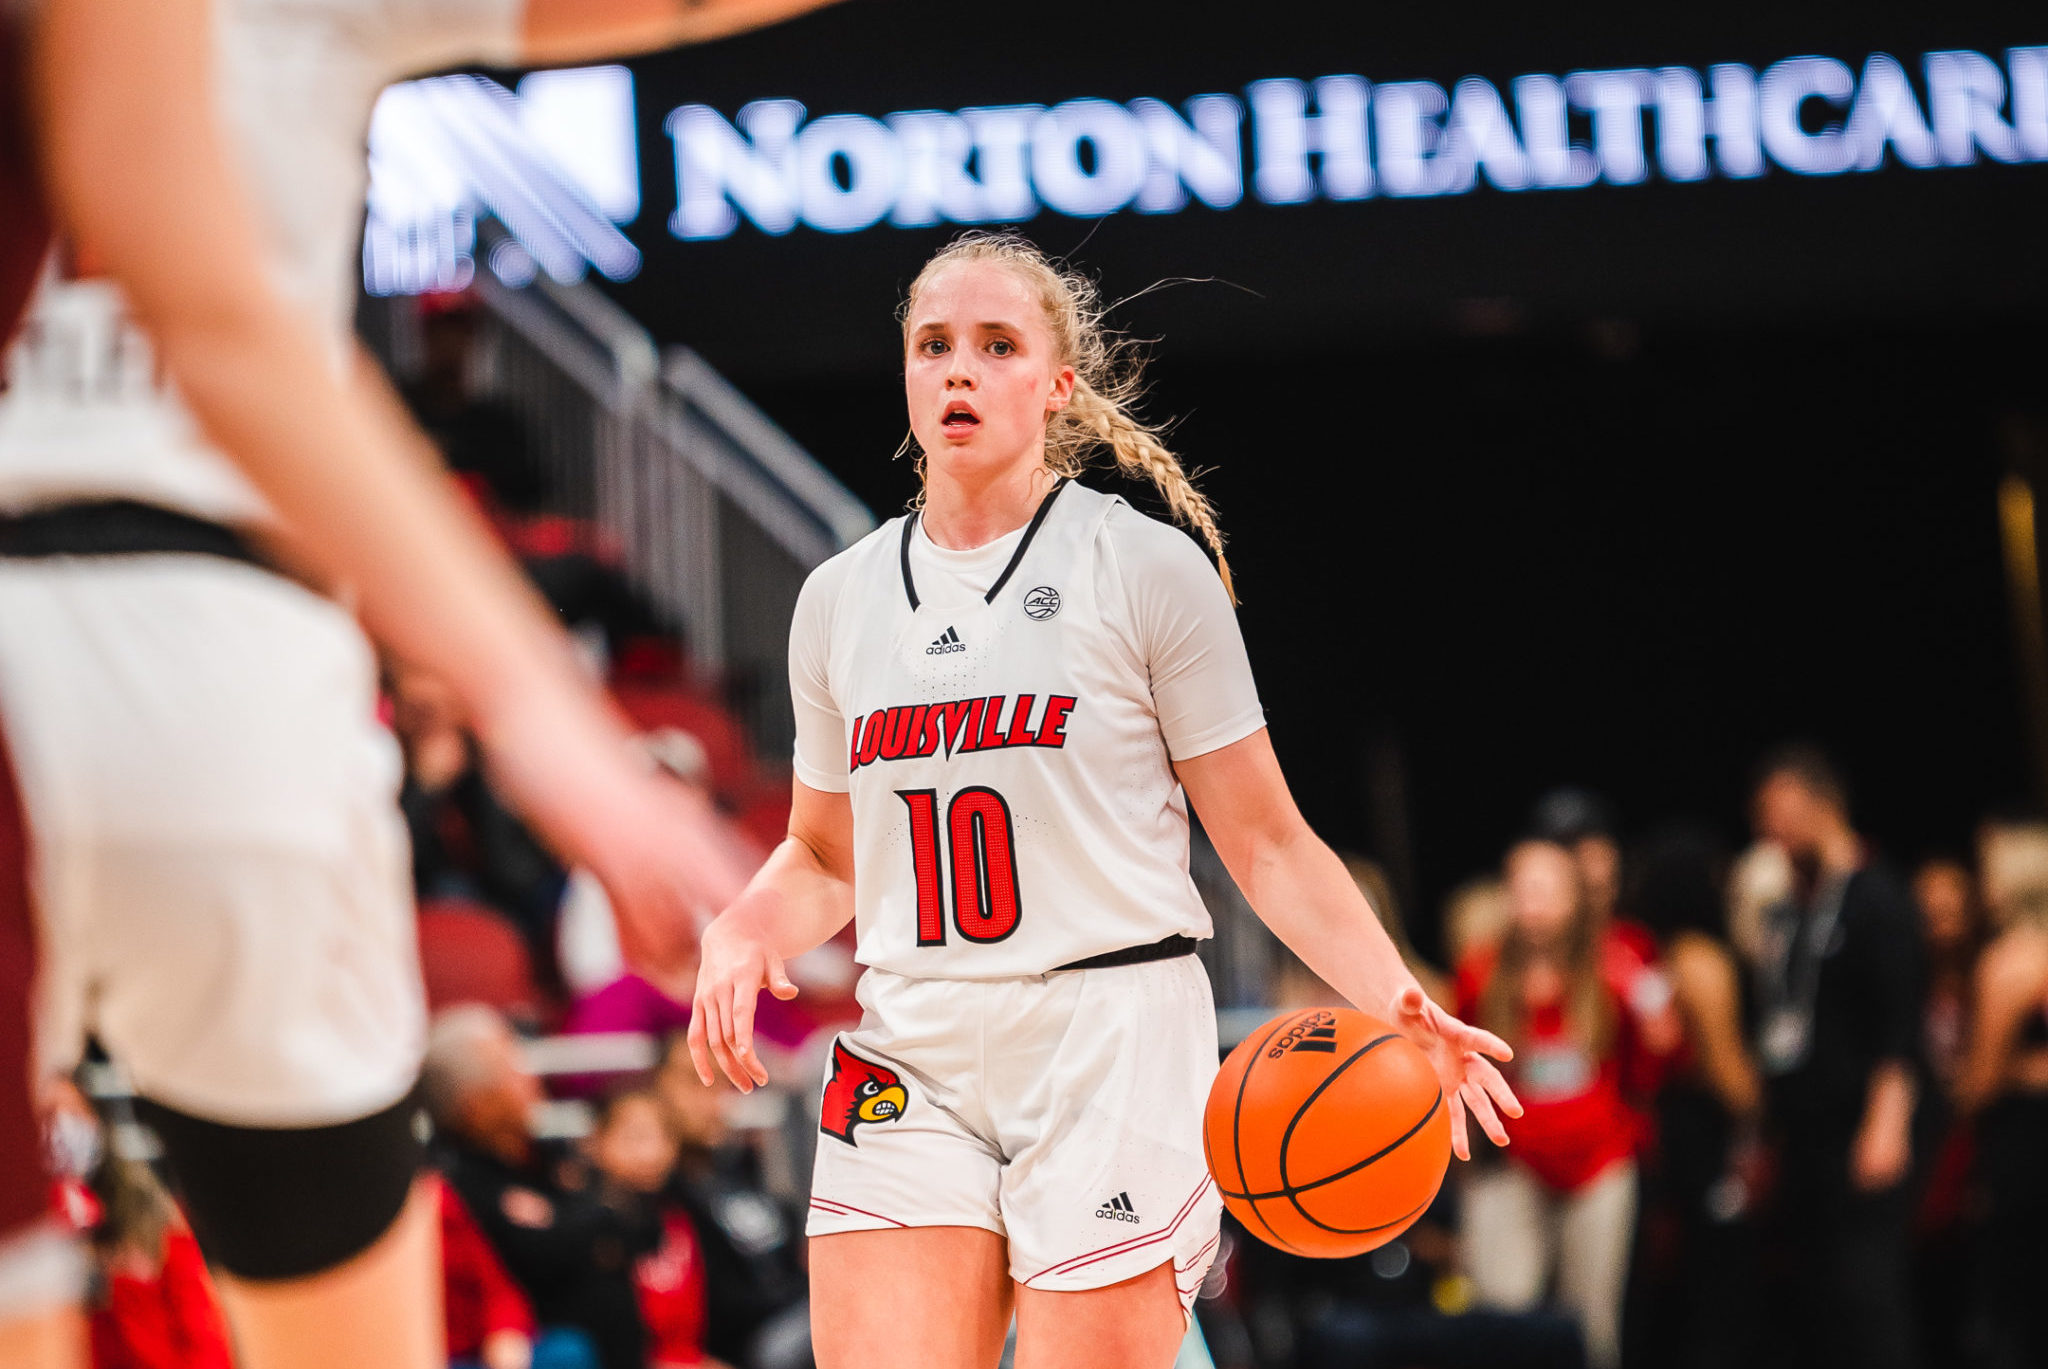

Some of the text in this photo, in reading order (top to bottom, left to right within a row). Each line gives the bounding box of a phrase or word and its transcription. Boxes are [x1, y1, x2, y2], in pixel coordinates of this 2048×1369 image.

[663, 93, 1244, 241] NORTON
[925, 643, 967, 656] adidas
[850, 694, 1078, 774] LOUISVILLE
[893, 785, 1023, 948] 10
[1268, 1010, 1332, 1059] adidas
[1095, 1208, 1140, 1225] adidas
